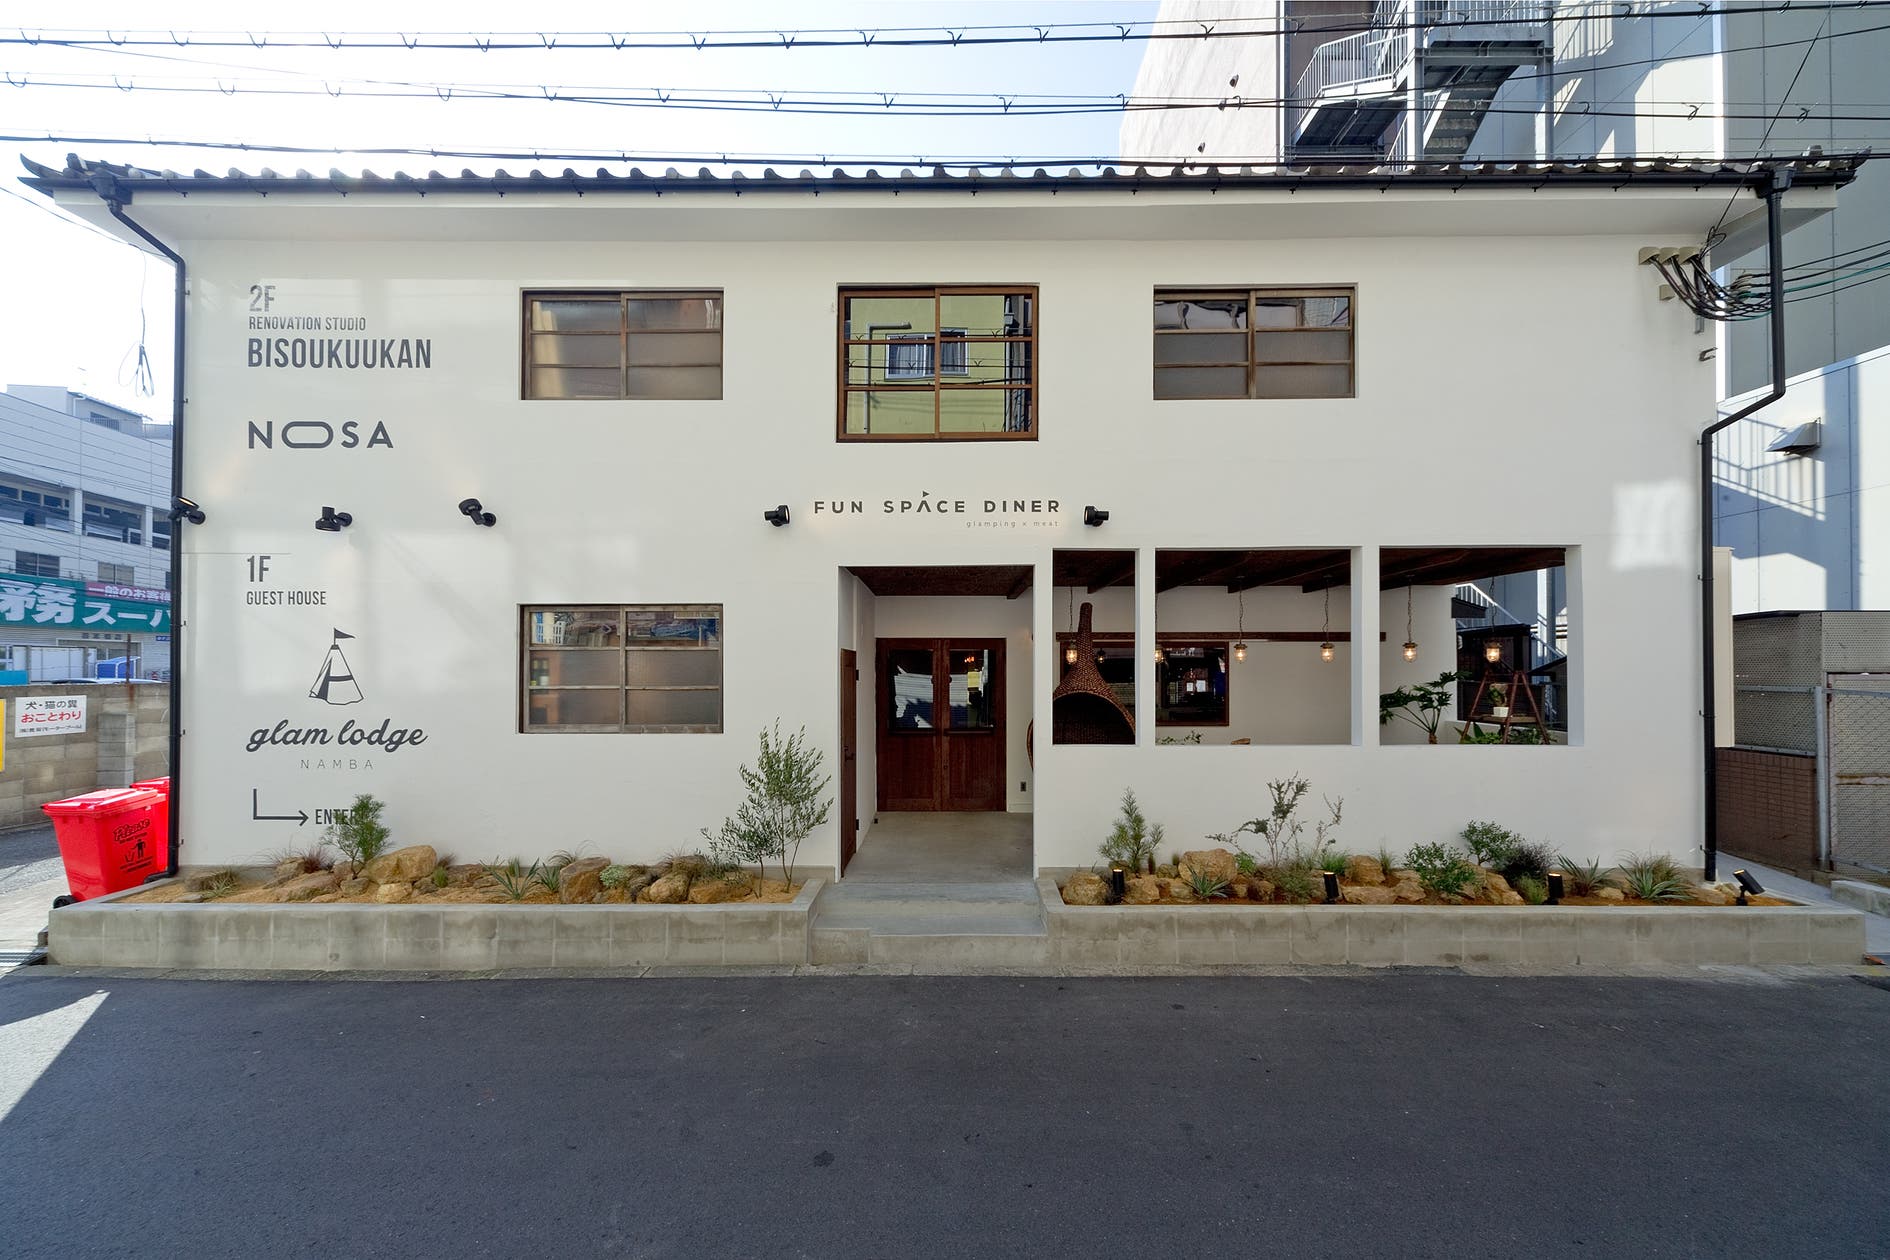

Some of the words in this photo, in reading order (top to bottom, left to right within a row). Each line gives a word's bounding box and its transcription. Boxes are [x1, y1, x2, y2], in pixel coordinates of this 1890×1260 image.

[249, 284, 276, 312] 2F
[249, 316, 321, 331] RENOVATION
[325, 317, 366, 331] STUDIO
[247, 337, 431, 369] BISOUKUUKAN
[248, 420, 394, 449] NOSA
[814, 500, 864, 514] FUN
[883, 499, 966, 514] SPACE
[983, 500, 1060, 513] DINER
[246, 555, 271, 582] 1F
[246, 590, 284, 606] GUEST
[287, 590, 327, 606] HOUSE
[21, 710, 82, 723] おことわり
[245, 719, 334, 752] glam
[337, 718, 429, 752] lodge
[300, 759, 373, 769] NAMBA
